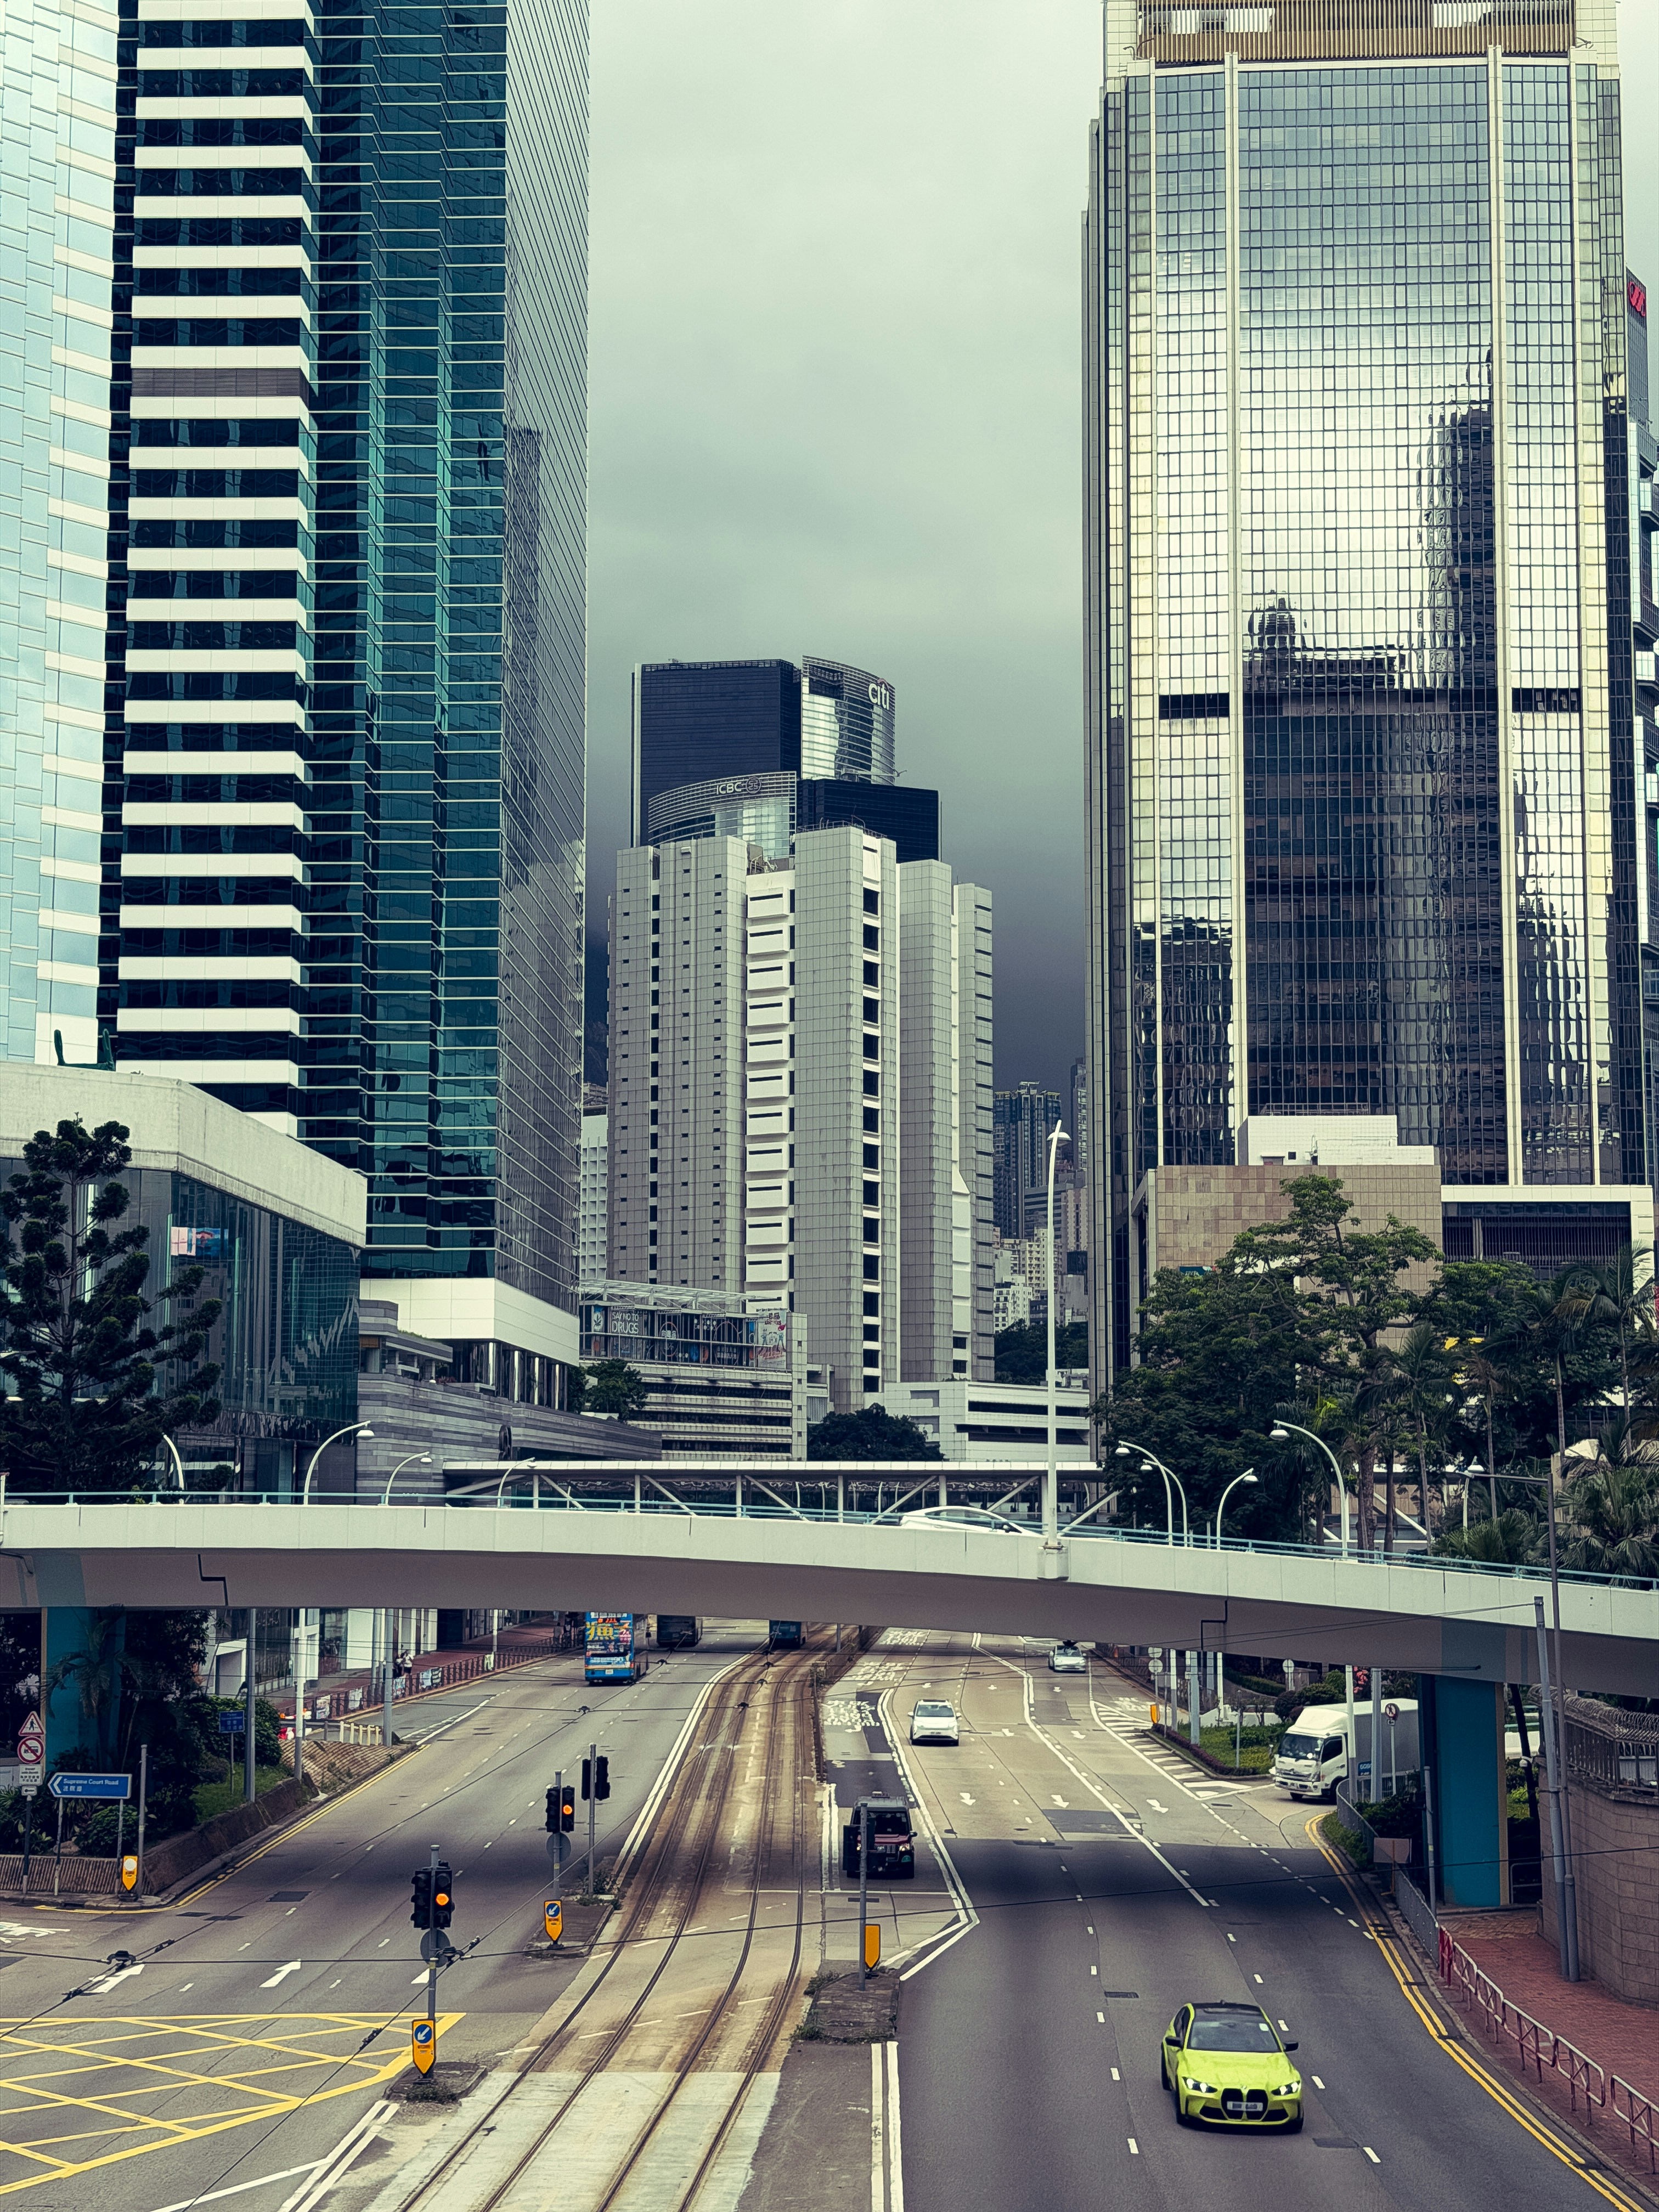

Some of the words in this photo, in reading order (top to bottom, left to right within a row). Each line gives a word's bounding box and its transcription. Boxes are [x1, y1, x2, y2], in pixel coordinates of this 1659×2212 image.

[716, 782, 742, 795] ICBC
[612, 1312, 622, 1320] SAY
[623, 1313, 631, 1321] NO
[631, 1313, 639, 1322] TO
[612, 1321, 639, 1334] DRUGS
